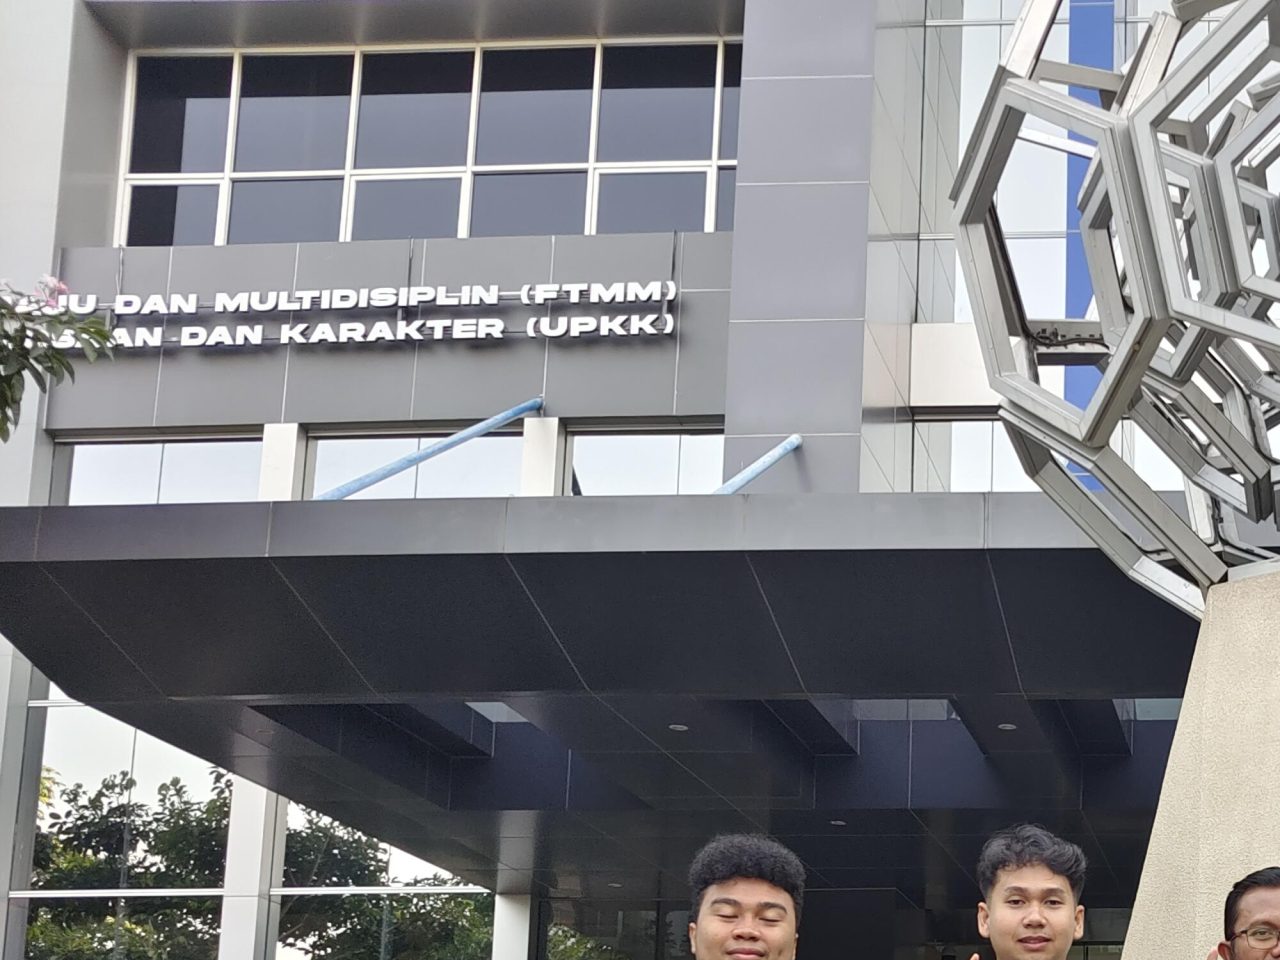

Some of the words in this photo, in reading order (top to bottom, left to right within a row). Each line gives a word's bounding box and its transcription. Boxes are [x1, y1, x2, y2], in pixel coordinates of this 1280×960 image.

[115, 293, 198, 315] DAN
[214, 285, 499, 312] MULTIDISIPLIN
[520, 281, 677, 305] (FTMM)
[180, 324, 263, 346] DAN
[280, 318, 505, 344] KARAKTER
[526, 313, 674, 337] (UPKK)
